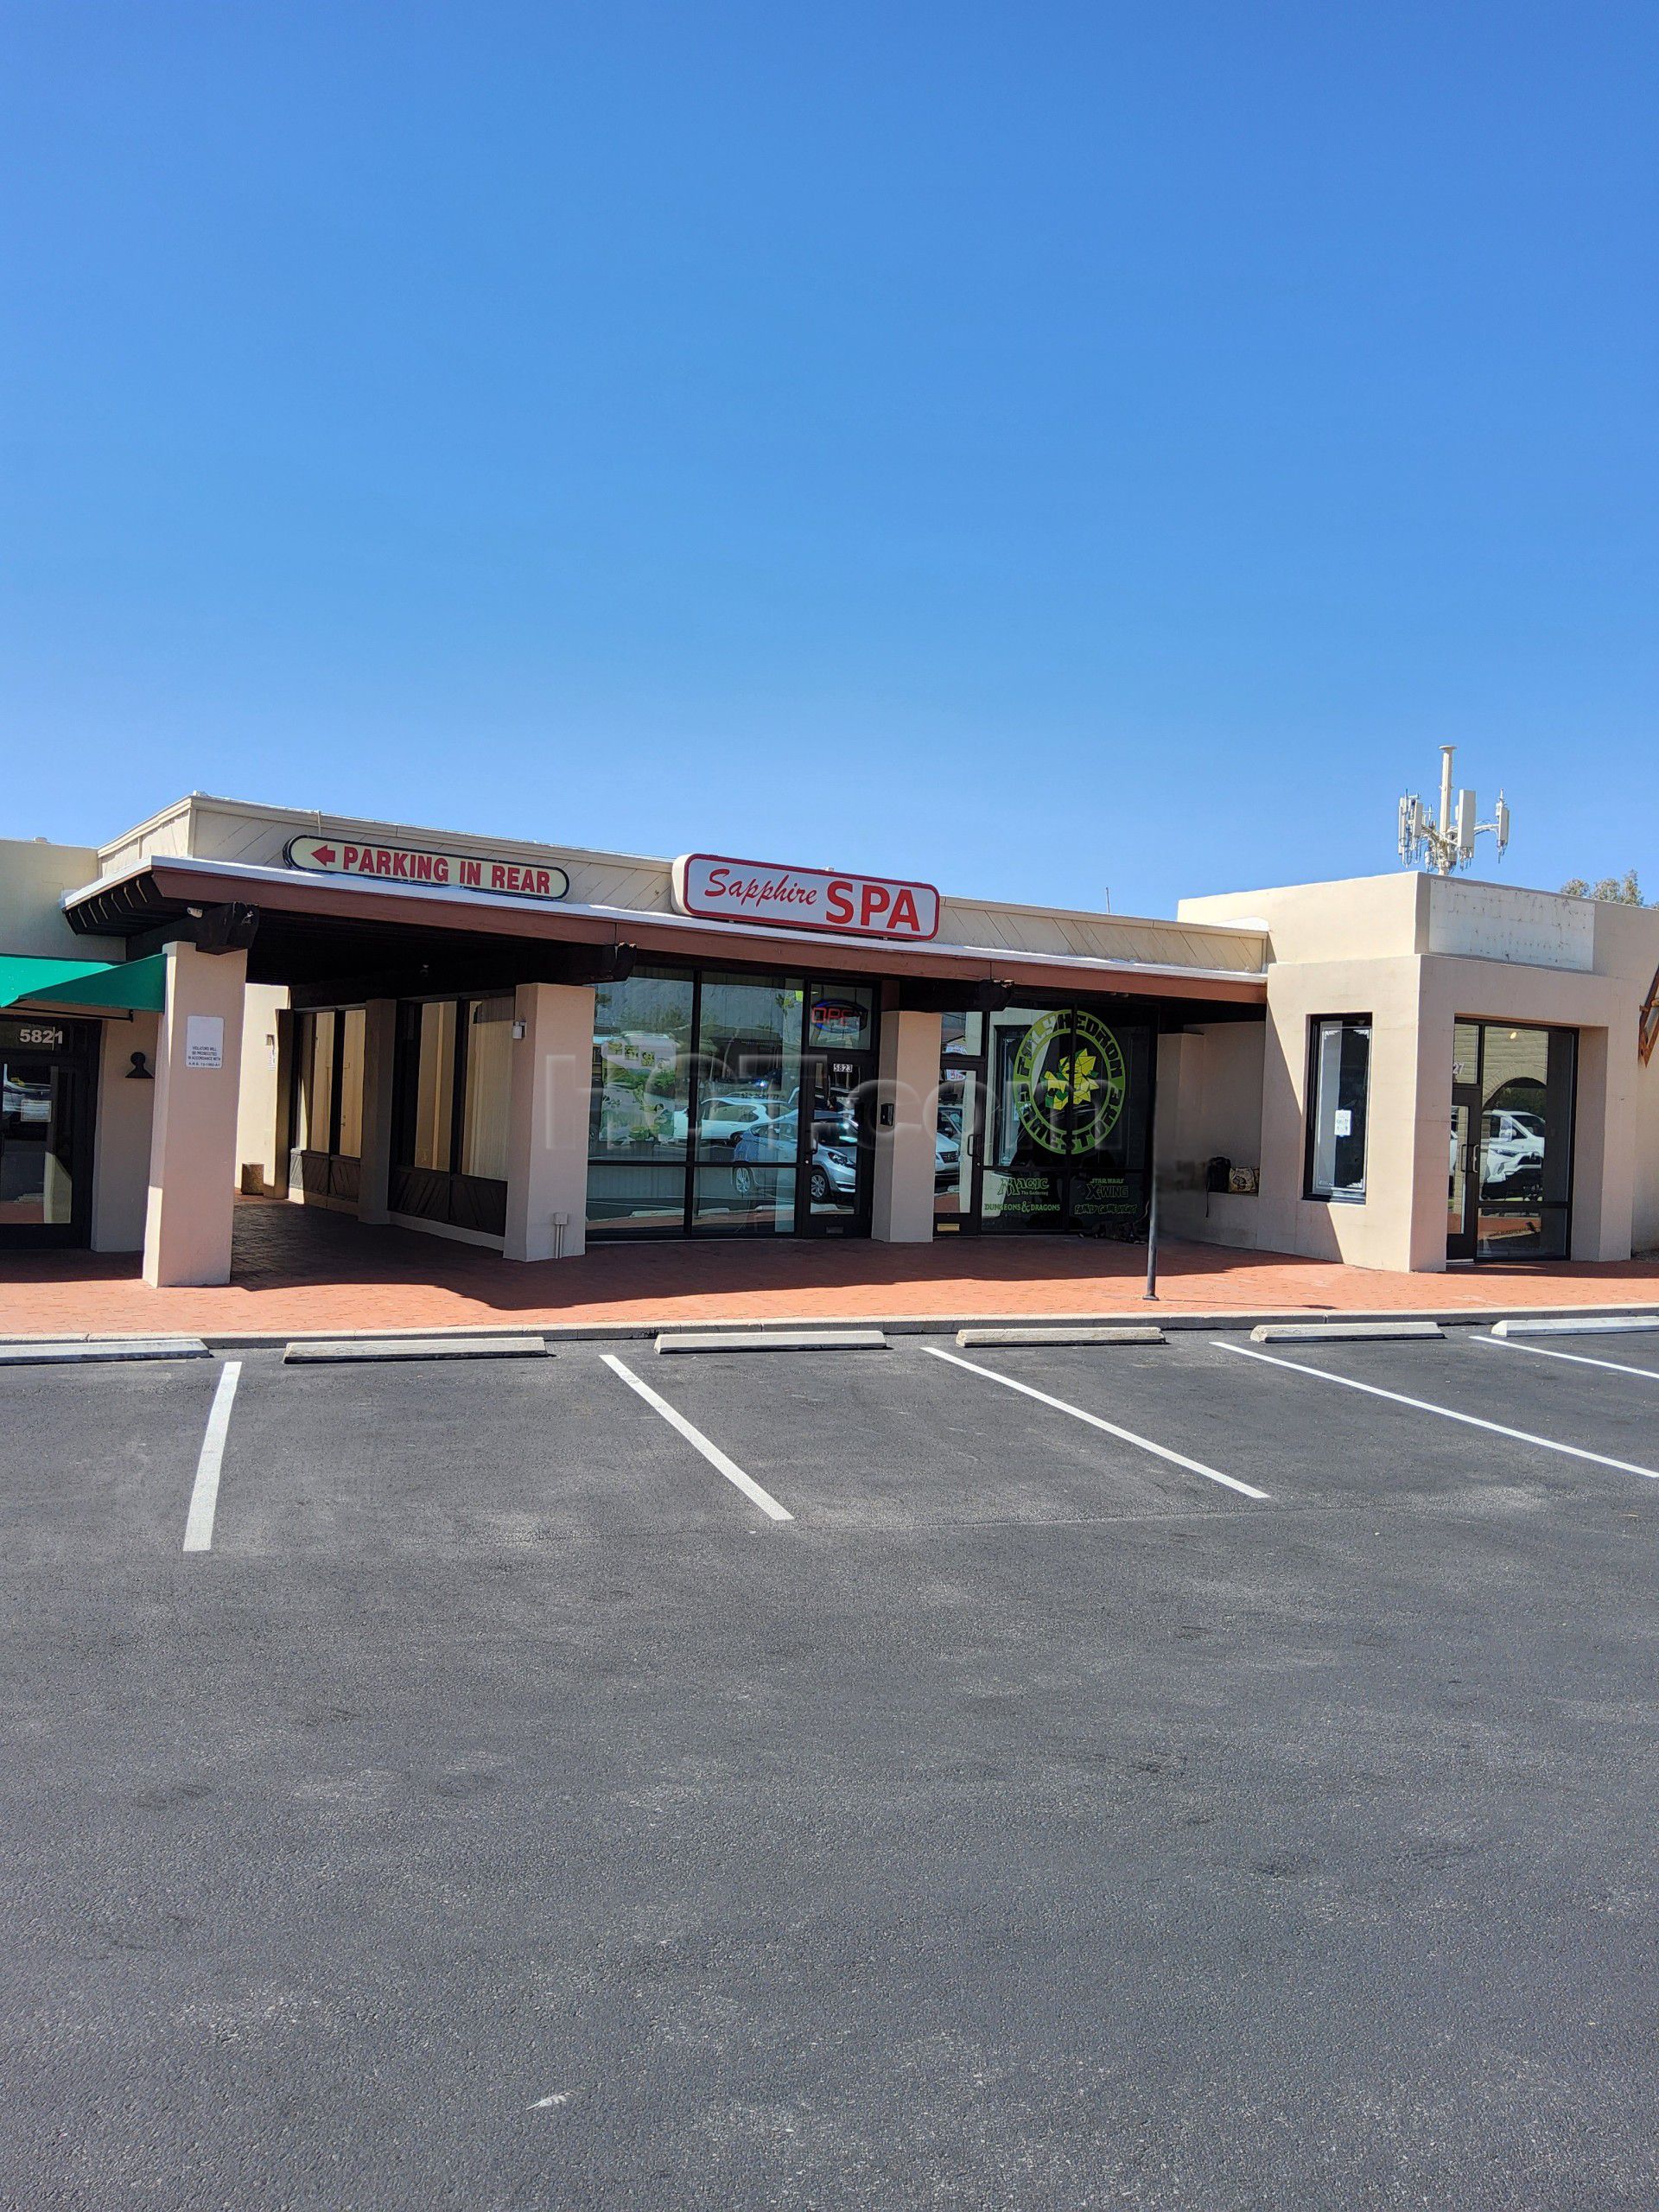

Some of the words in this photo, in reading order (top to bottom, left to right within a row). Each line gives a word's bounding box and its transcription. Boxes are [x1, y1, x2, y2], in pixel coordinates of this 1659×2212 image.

[342, 845, 449, 882] PARKING
[459, 861, 481, 886] IN
[491, 865, 550, 894] REAR
[704, 868, 817, 907] Sapphire
[825, 880, 921, 932] SPA
[19, 1028, 63, 1045] 5821
[834, 1064, 852, 1072] 5823
[1021, 1201, 1031, 1213] &
